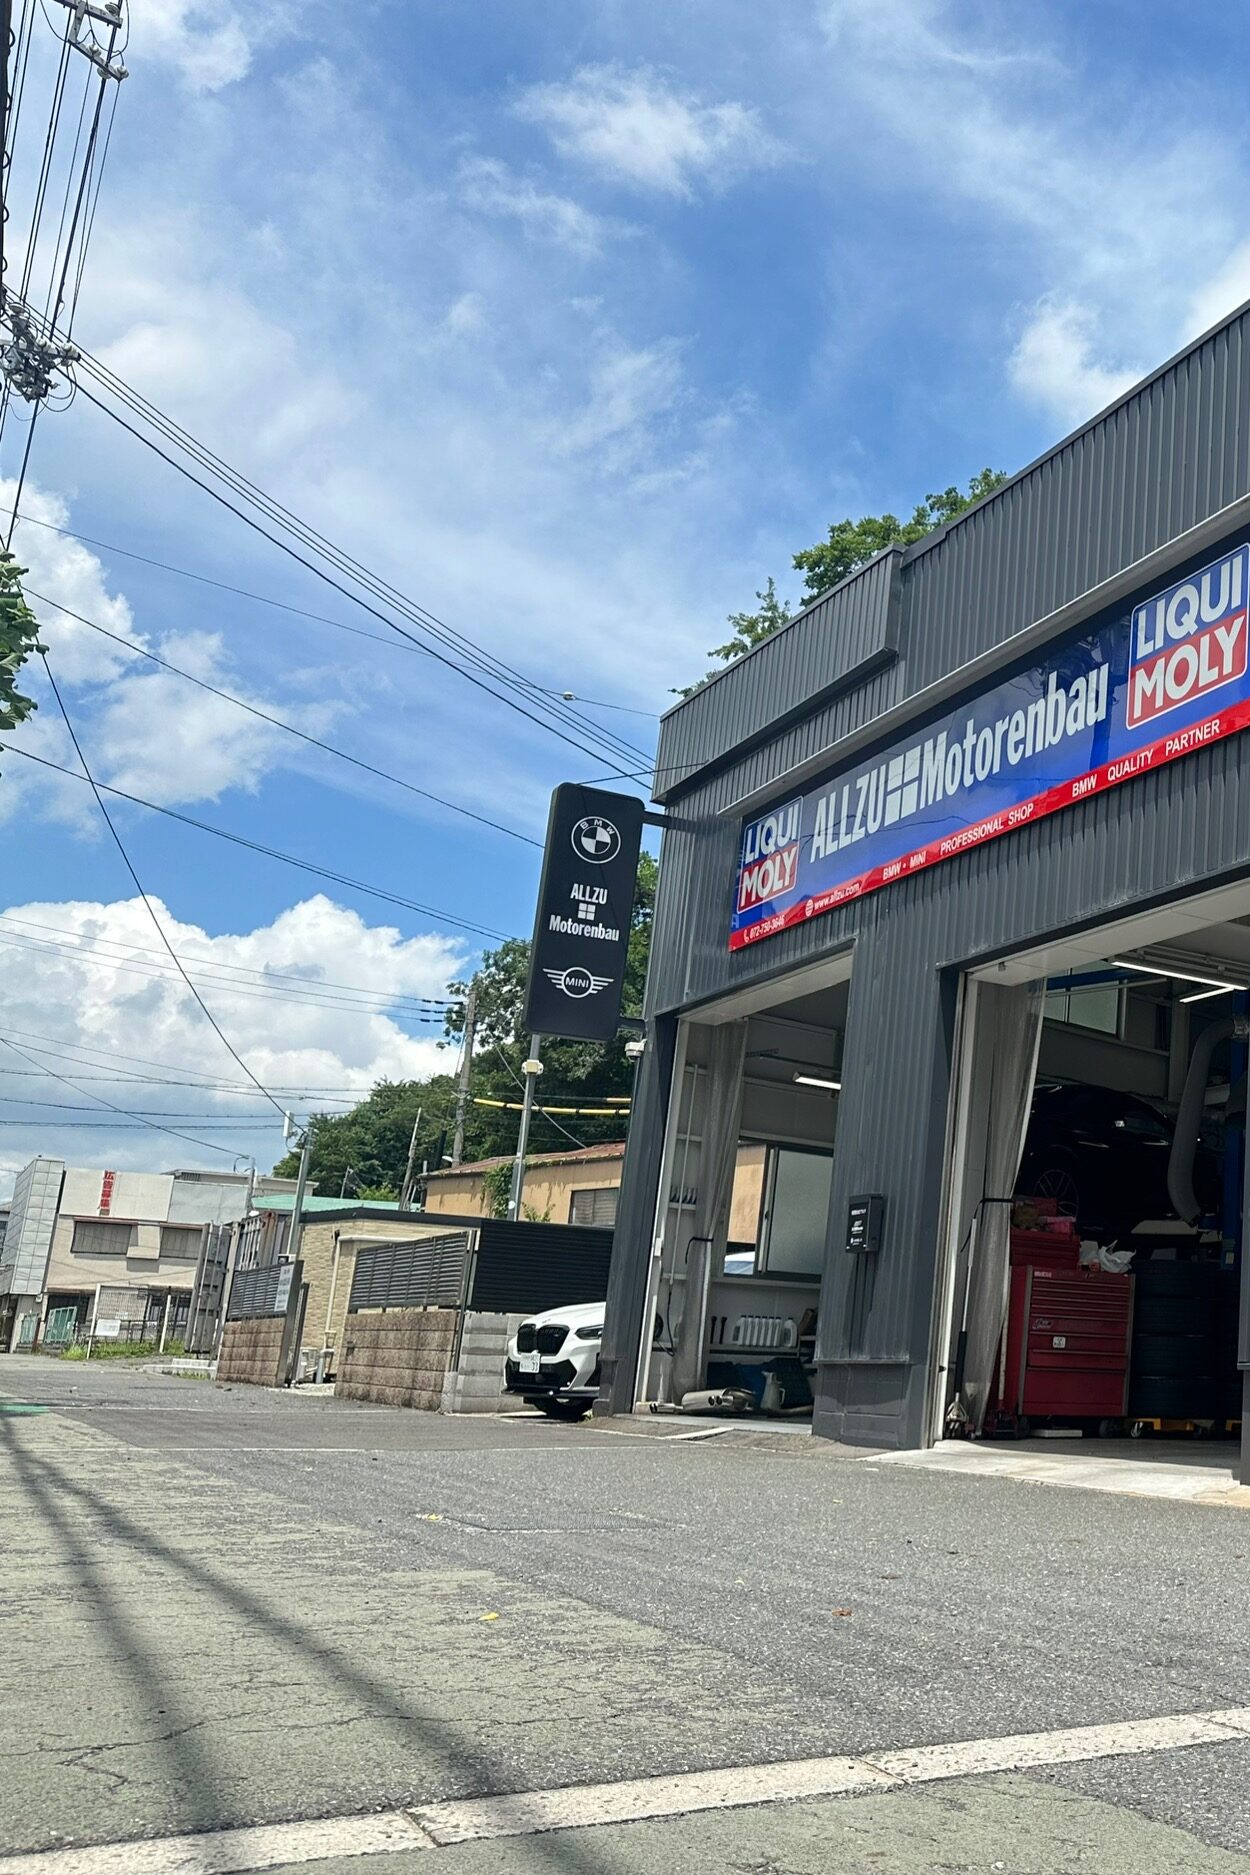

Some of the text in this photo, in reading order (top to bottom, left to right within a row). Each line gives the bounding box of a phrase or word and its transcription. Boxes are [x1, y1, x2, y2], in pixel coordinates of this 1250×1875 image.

[1136, 554, 1243, 660] LIQUI
[1134, 614, 1245, 718] MOLY
[810, 662, 1109, 863] ALLZU Motorenbau
[580, 819, 615, 836] BMW
[882, 719, 1220, 880] BMW MINI PROFESSIONAL SHOP BMW QUALITY PARTNER
[745, 803, 799, 864] LIQUI
[570, 883, 608, 905] ALLZU
[740, 846, 798, 907] MOLY
[814, 883, 860, 910] www.allzu.com
[549, 915, 620, 942] Motorenbau
[565, 976, 590, 989] MINI
